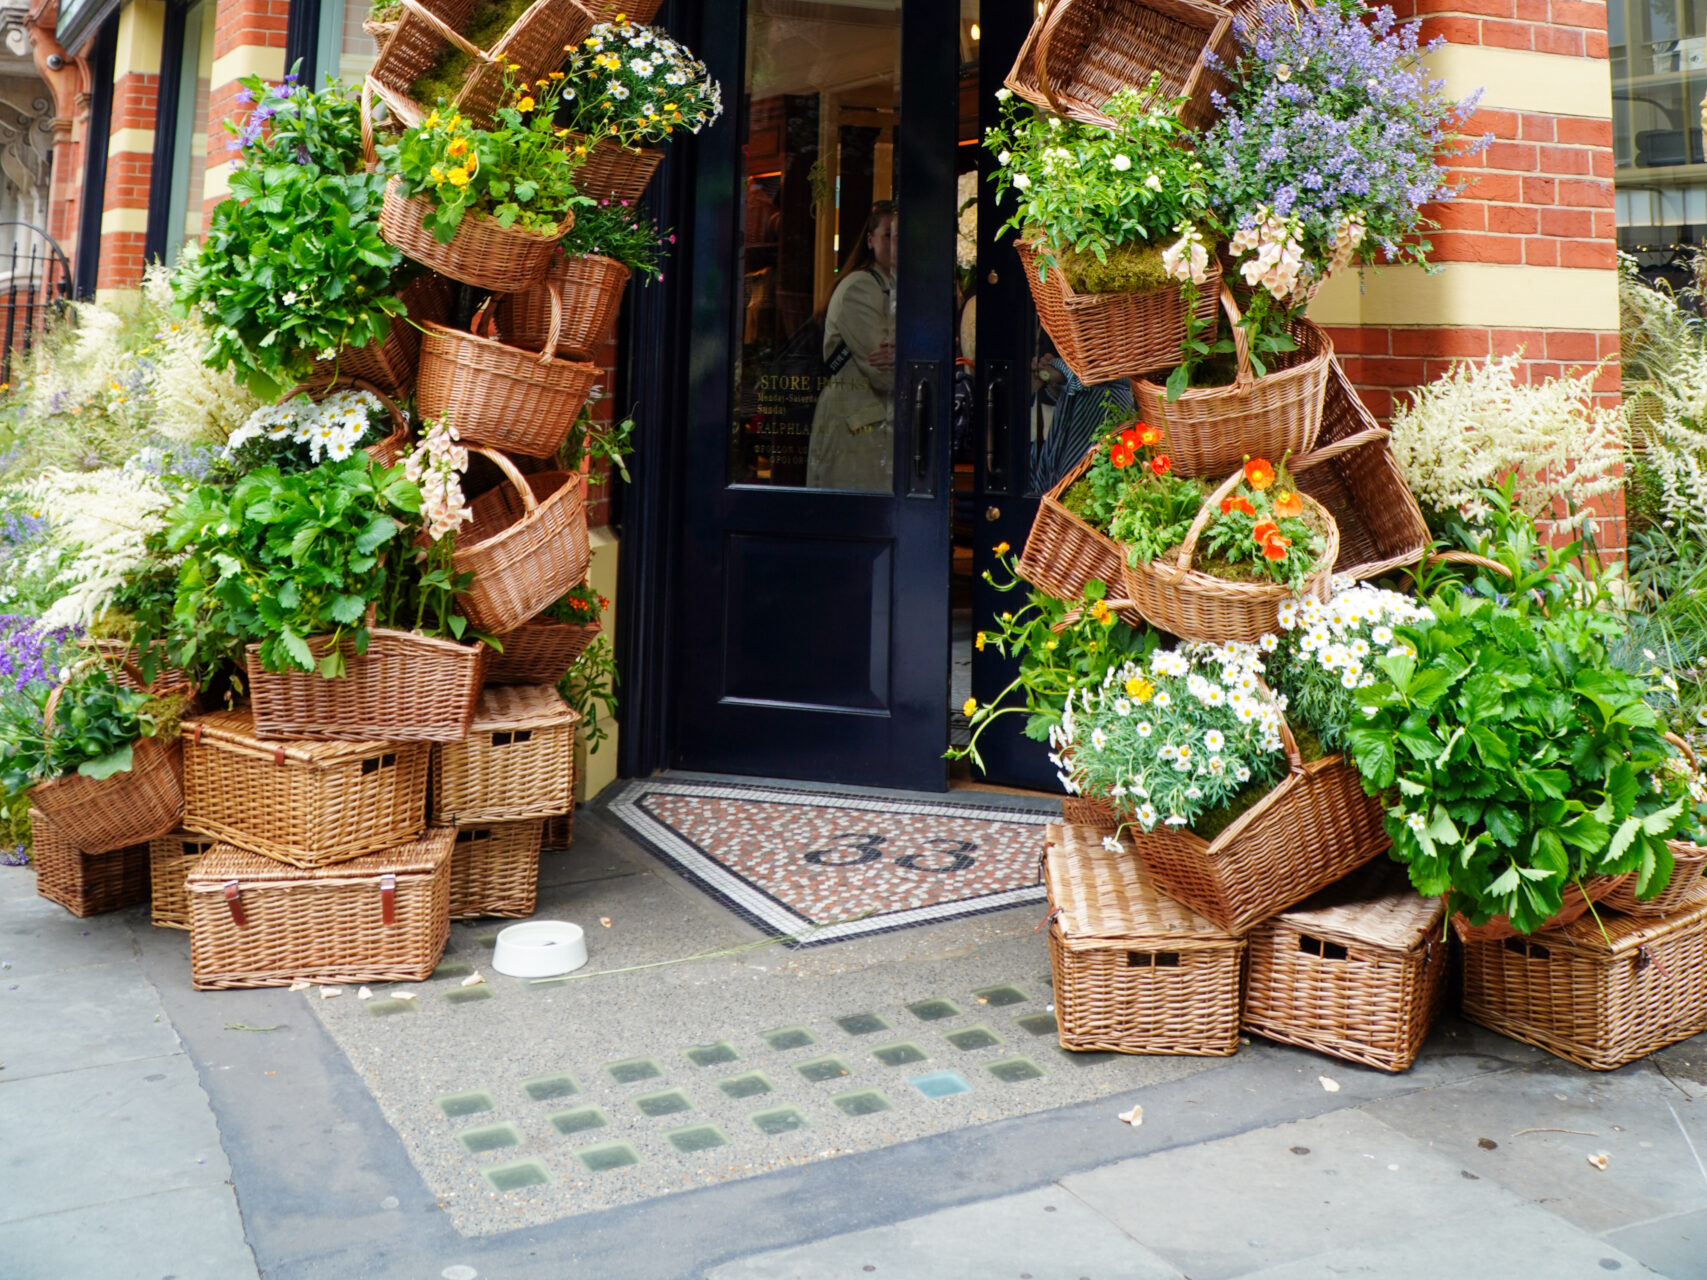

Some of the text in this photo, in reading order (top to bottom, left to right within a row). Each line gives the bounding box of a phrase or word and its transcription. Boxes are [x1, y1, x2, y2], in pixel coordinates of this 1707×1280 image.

[760, 375, 810, 391] STORE
[757, 404, 787, 416] Sunday
[803, 832, 980, 873] 33
